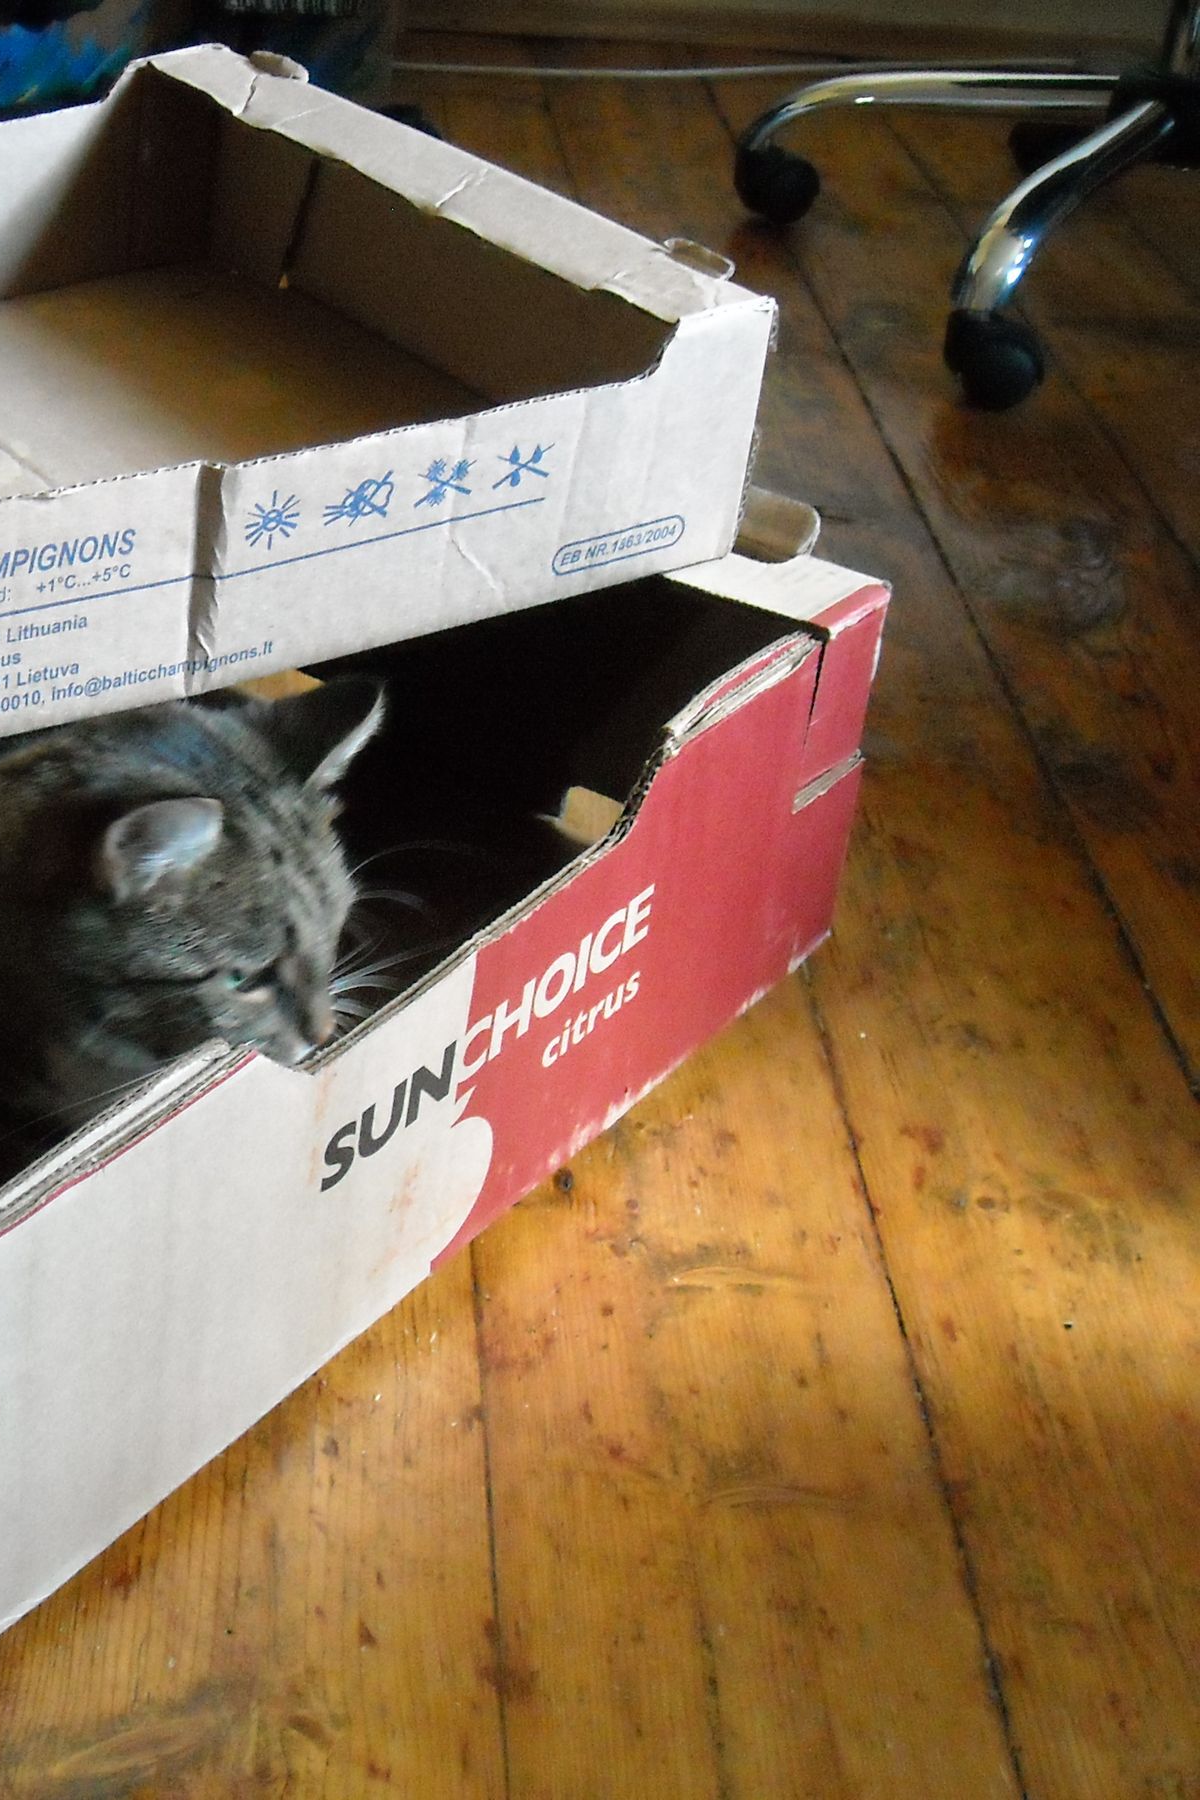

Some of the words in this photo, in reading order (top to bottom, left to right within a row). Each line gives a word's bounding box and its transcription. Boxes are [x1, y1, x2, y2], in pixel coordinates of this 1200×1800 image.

[560, 550, 582, 566] EB
[6, 614, 88, 643] Lithuania
[16, 662, 80, 687] Lietuva
[51, 641, 273, 701] info@balticchampignons.lt
[541, 971, 641, 1068] citrus
